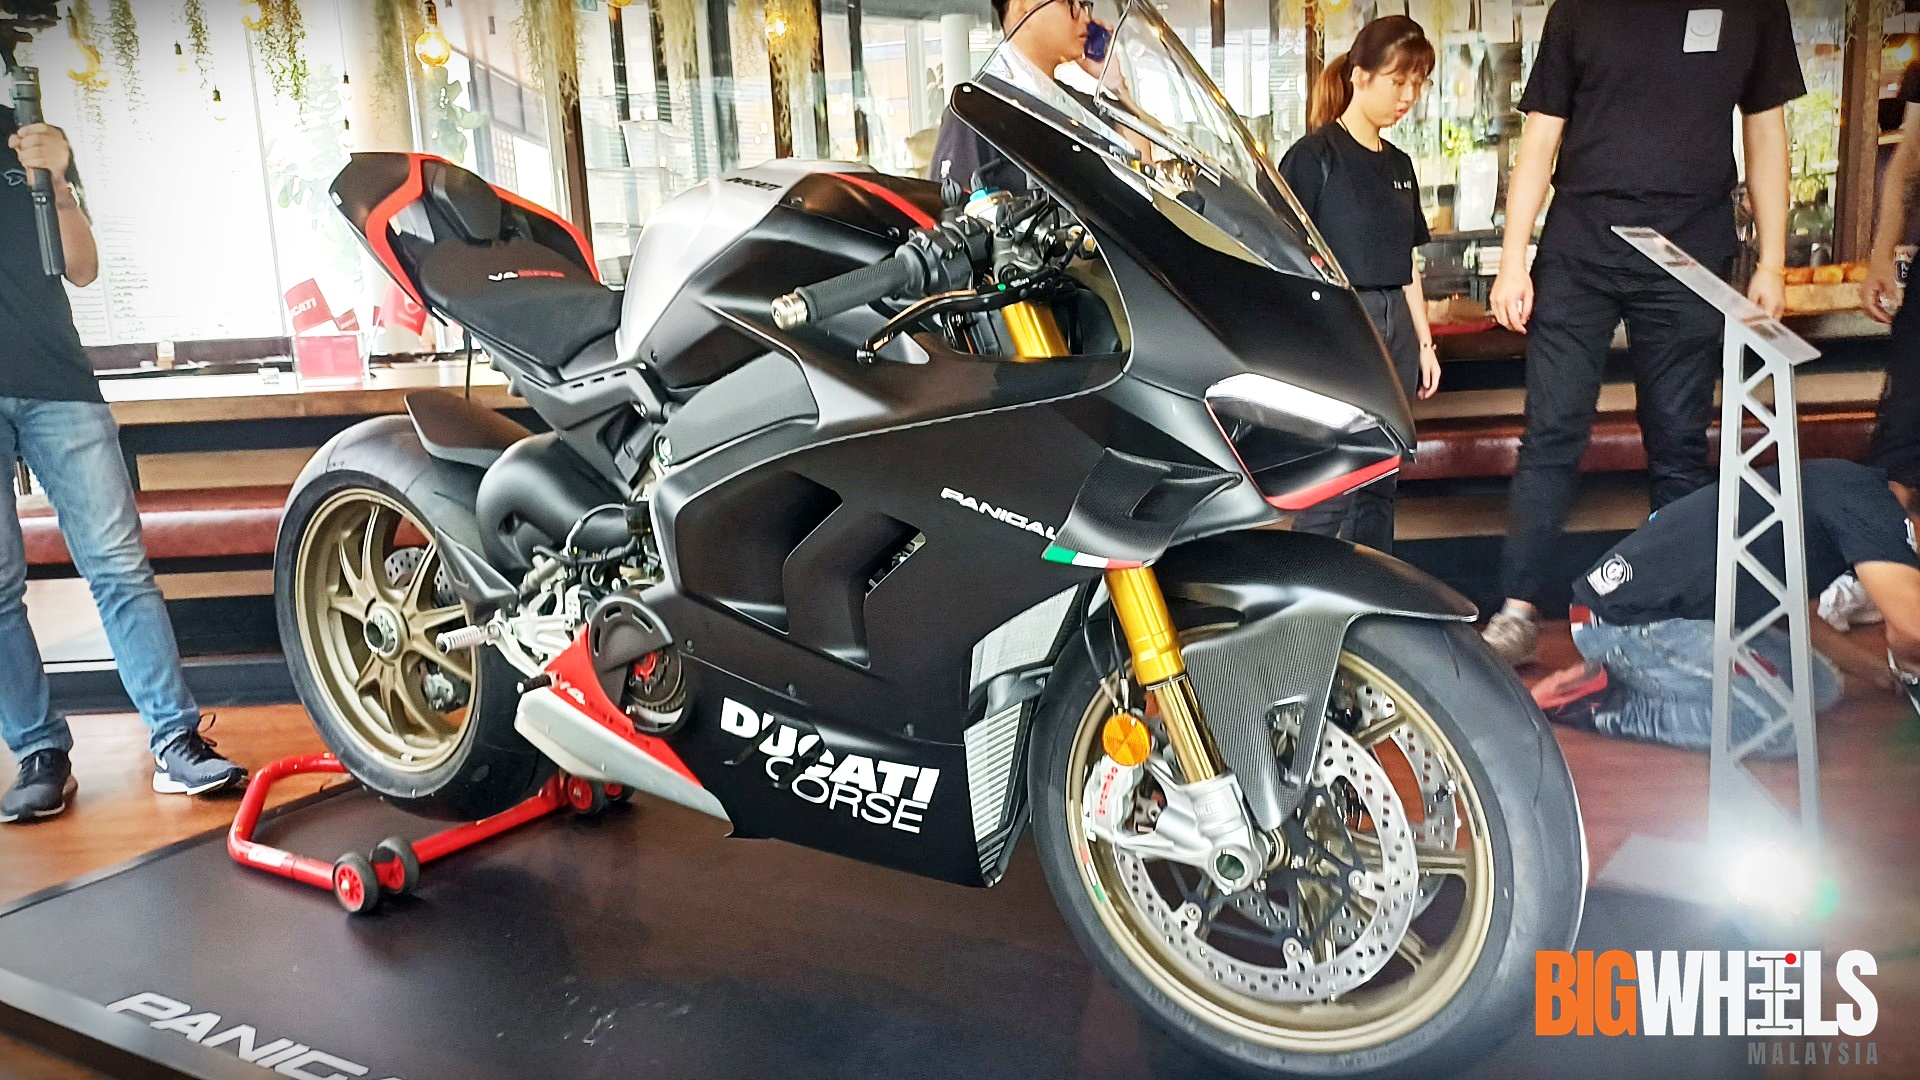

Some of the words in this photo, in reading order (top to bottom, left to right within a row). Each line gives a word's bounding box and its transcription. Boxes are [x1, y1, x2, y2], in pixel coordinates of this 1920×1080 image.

[289, 297, 317, 317] CATI
[720, 696, 941, 804] DUCATI
[765, 756, 928, 834] CORSE
[105, 992, 402, 1080] PANIG
